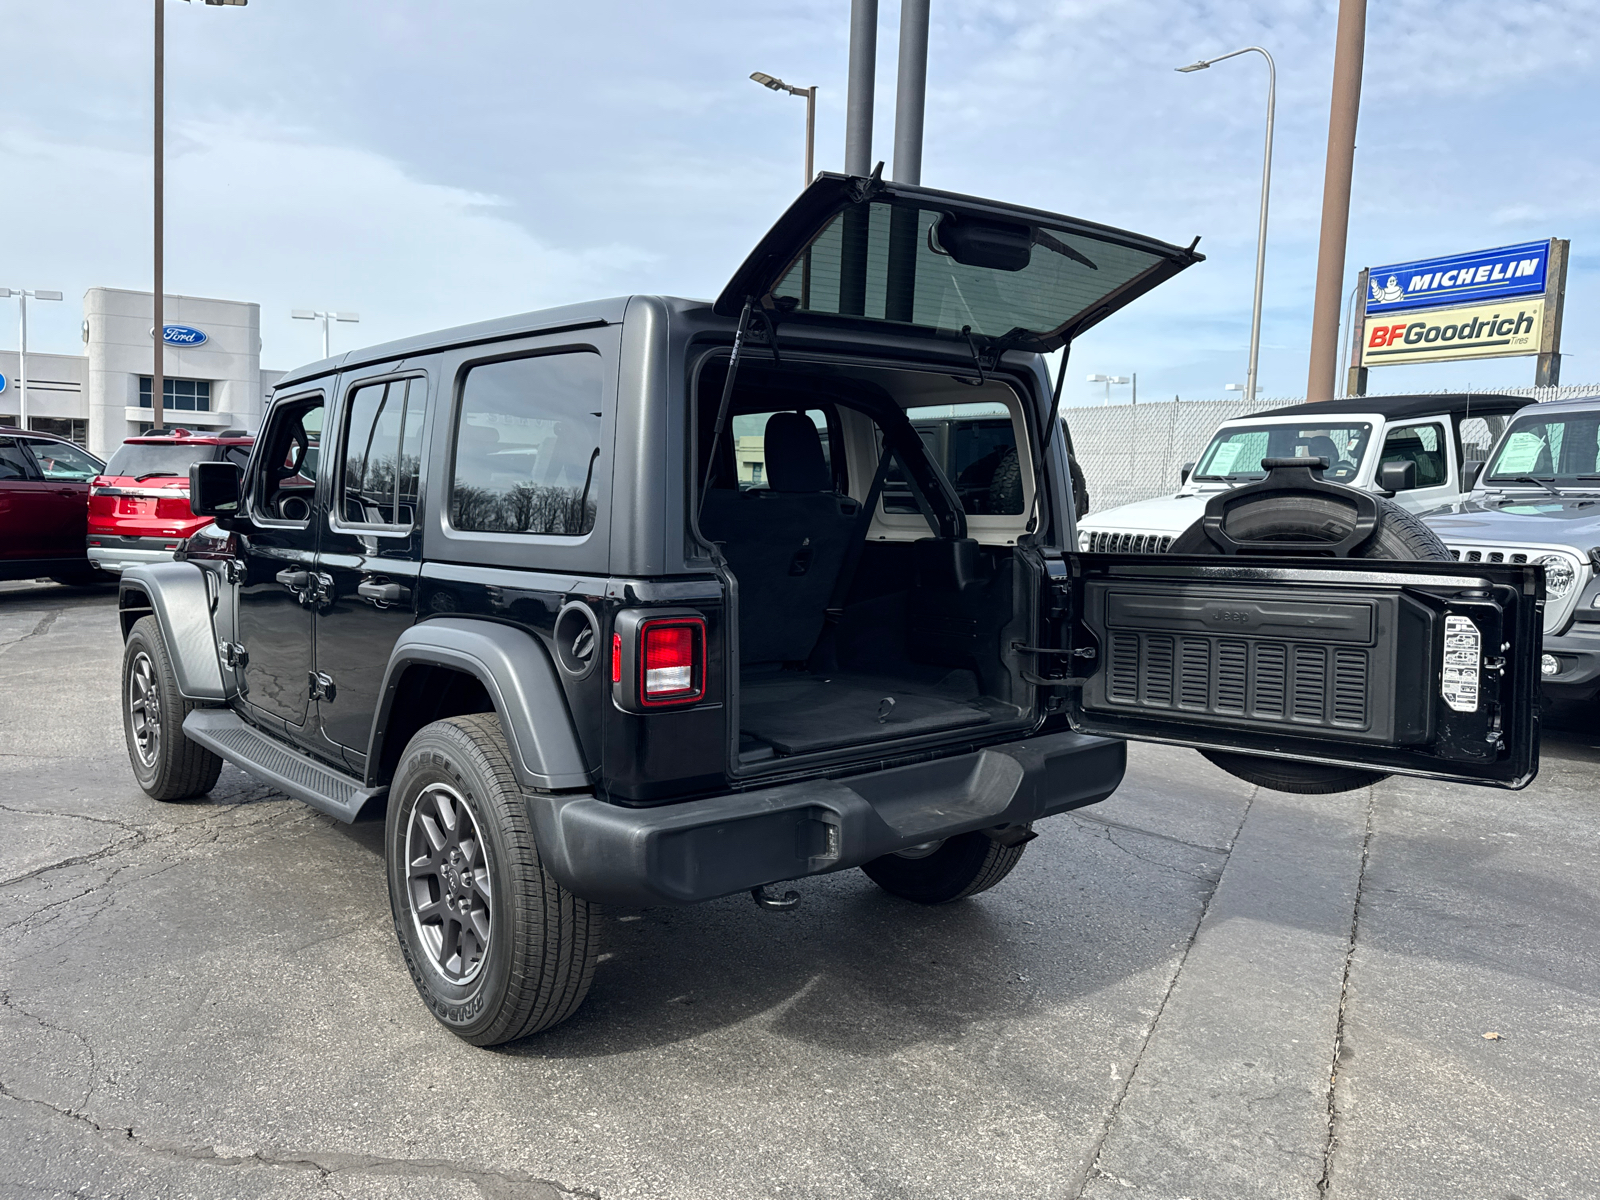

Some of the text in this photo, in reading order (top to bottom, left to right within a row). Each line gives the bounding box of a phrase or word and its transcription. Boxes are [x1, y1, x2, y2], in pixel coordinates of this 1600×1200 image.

[1407, 258, 1539, 292] MICHELIN
[163, 328, 196, 342] Ford
[1368, 311, 1534, 347] BFGoodrich
[1511, 336, 1529, 345] Tires
[1212, 608, 1250, 624] Jeep
[408, 751, 478, 814] DUELER
